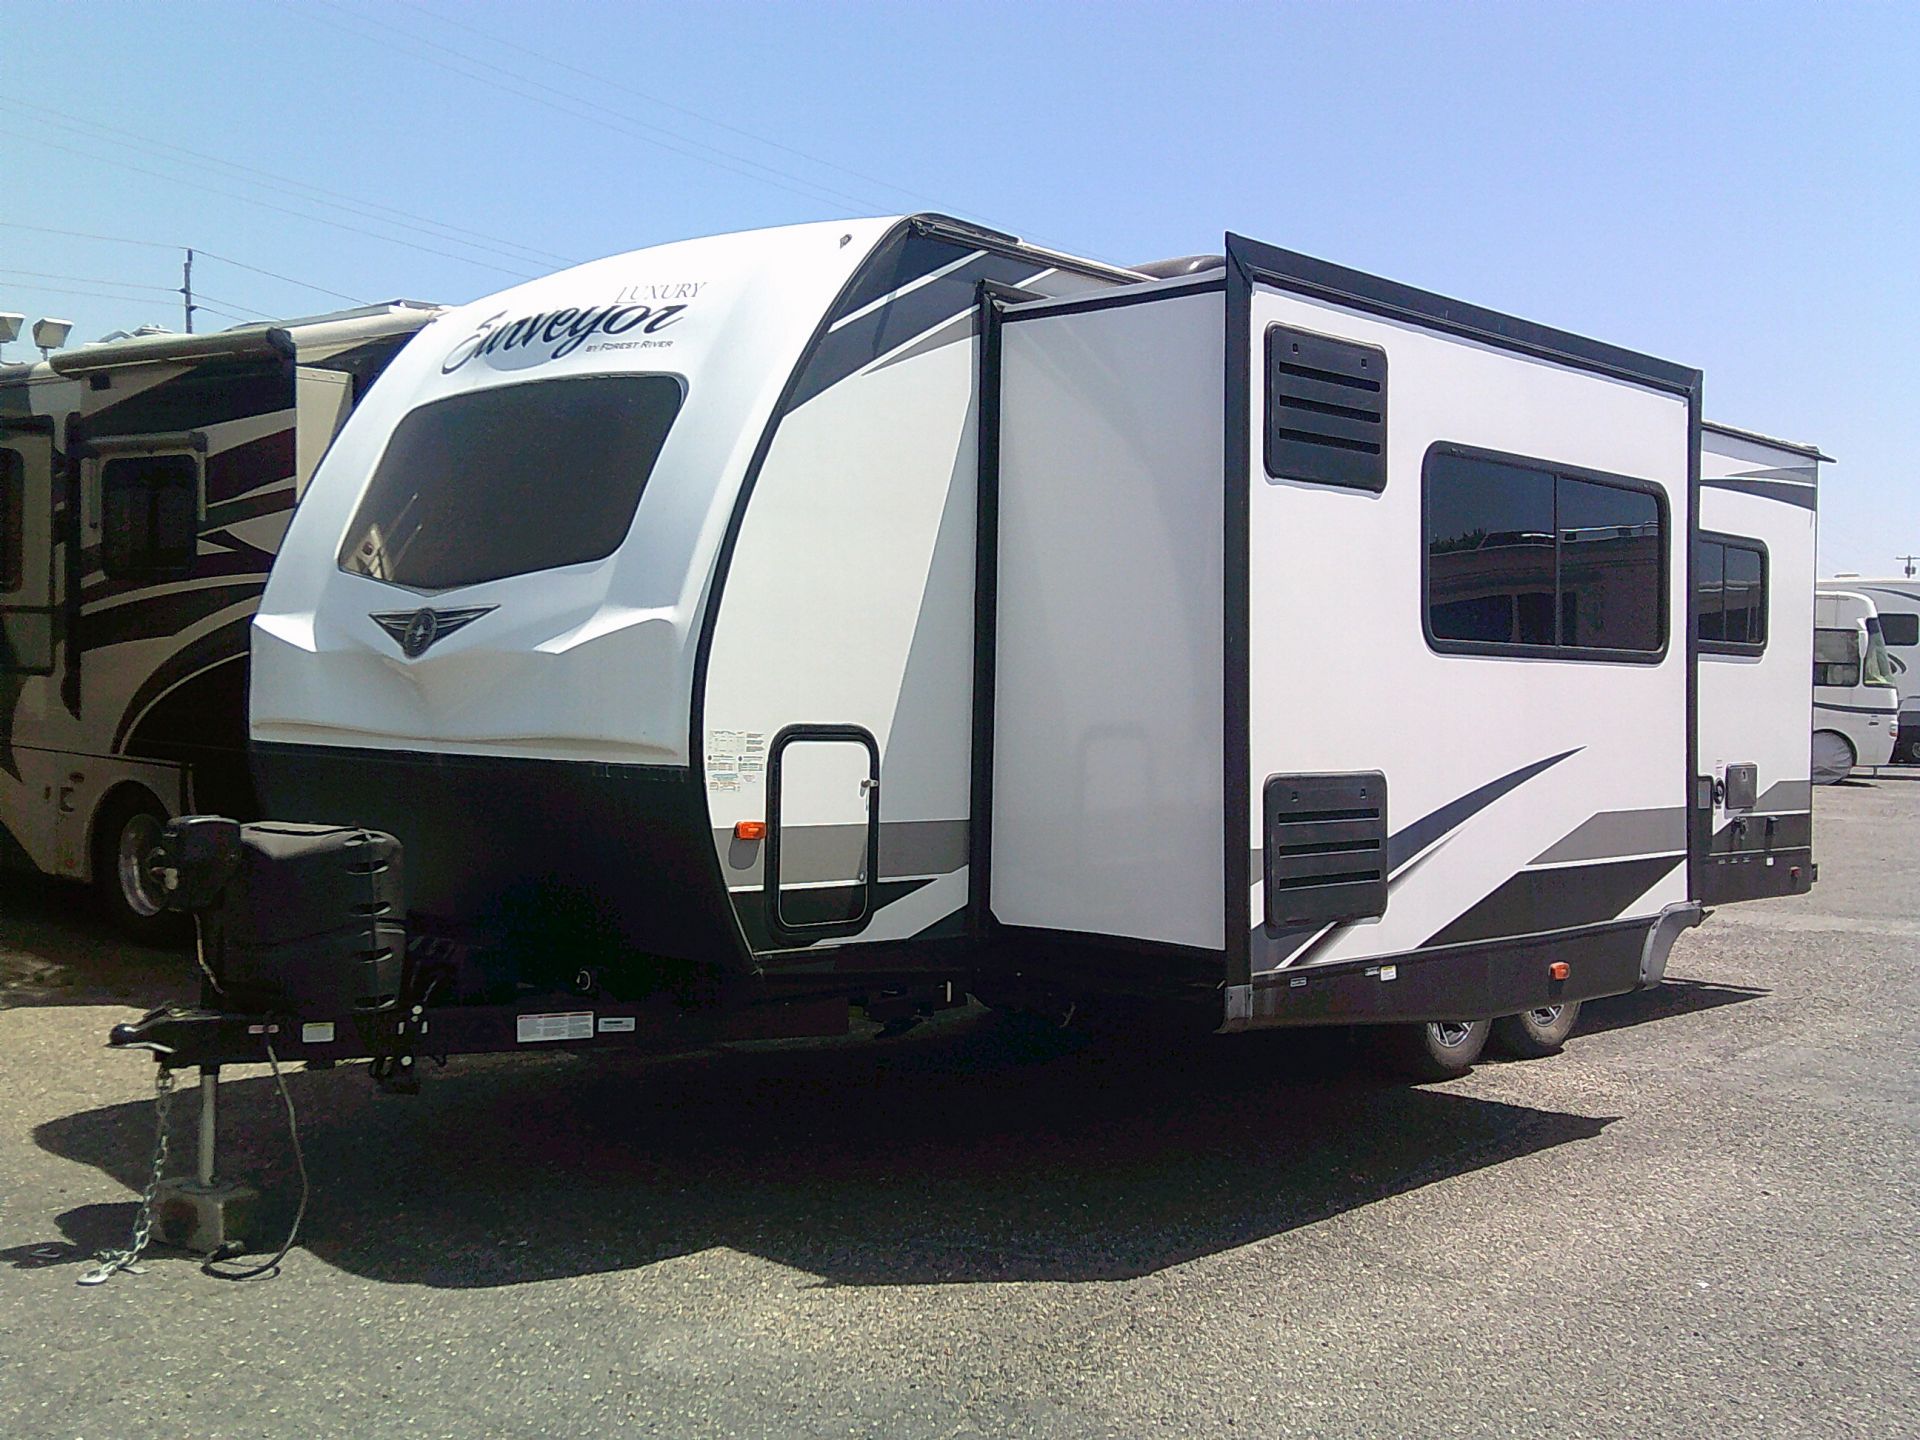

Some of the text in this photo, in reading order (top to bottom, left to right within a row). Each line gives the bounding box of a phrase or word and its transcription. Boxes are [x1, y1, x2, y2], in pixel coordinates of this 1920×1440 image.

[614, 281, 708, 304] LUXURY
[441, 303, 689, 376] Surveyor
[585, 340, 674, 353] BY FOREST RIVER
